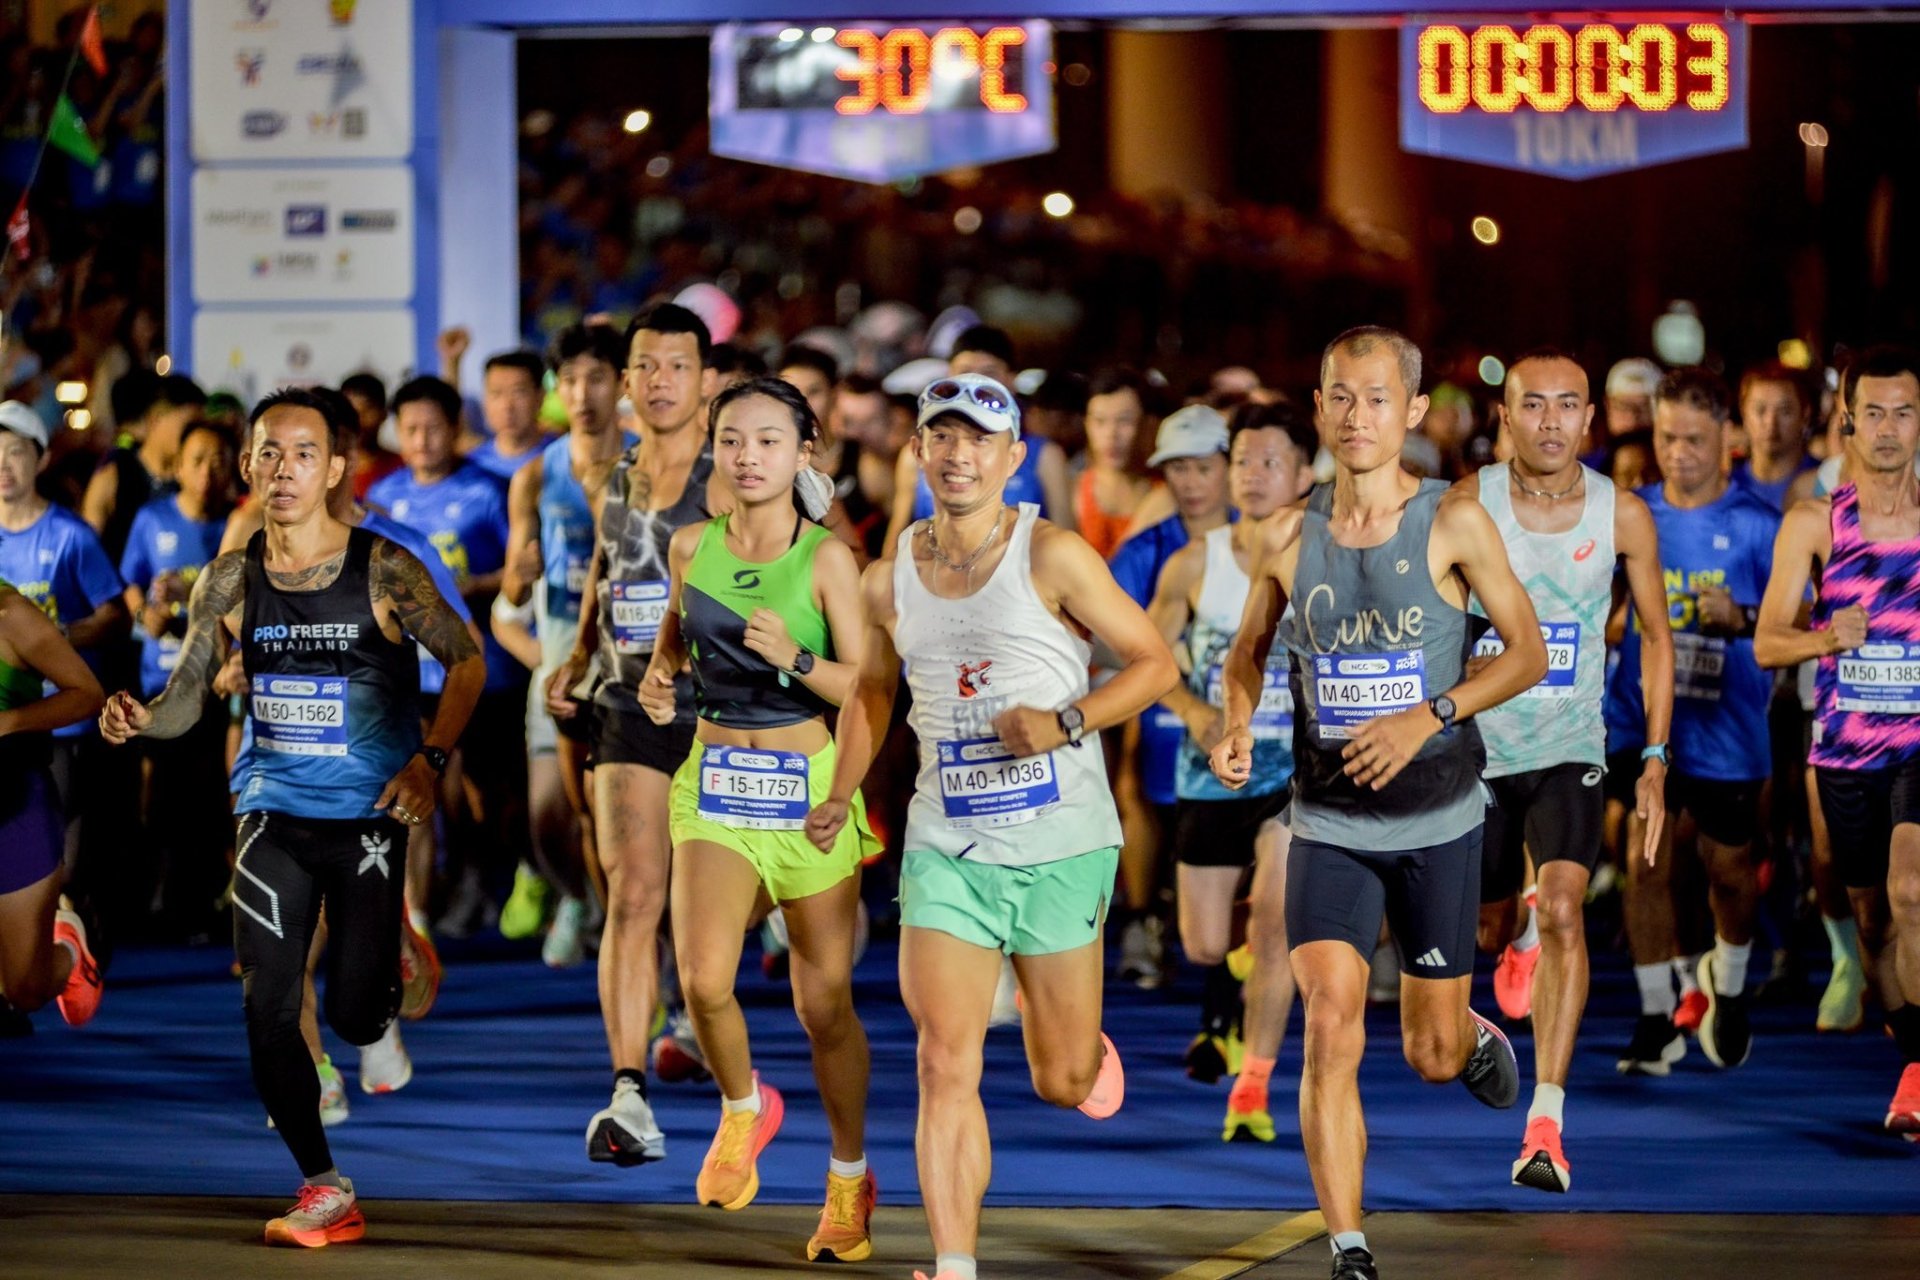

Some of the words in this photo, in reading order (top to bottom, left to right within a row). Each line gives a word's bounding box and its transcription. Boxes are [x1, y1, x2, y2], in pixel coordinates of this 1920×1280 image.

[1418, 23, 1729, 113] 00:00:03
[254, 625, 288, 642] PRO
[290, 624, 359, 638] FREEZE
[1304, 583, 1424, 654] Curve
[263, 640, 349, 652] THAILAND
